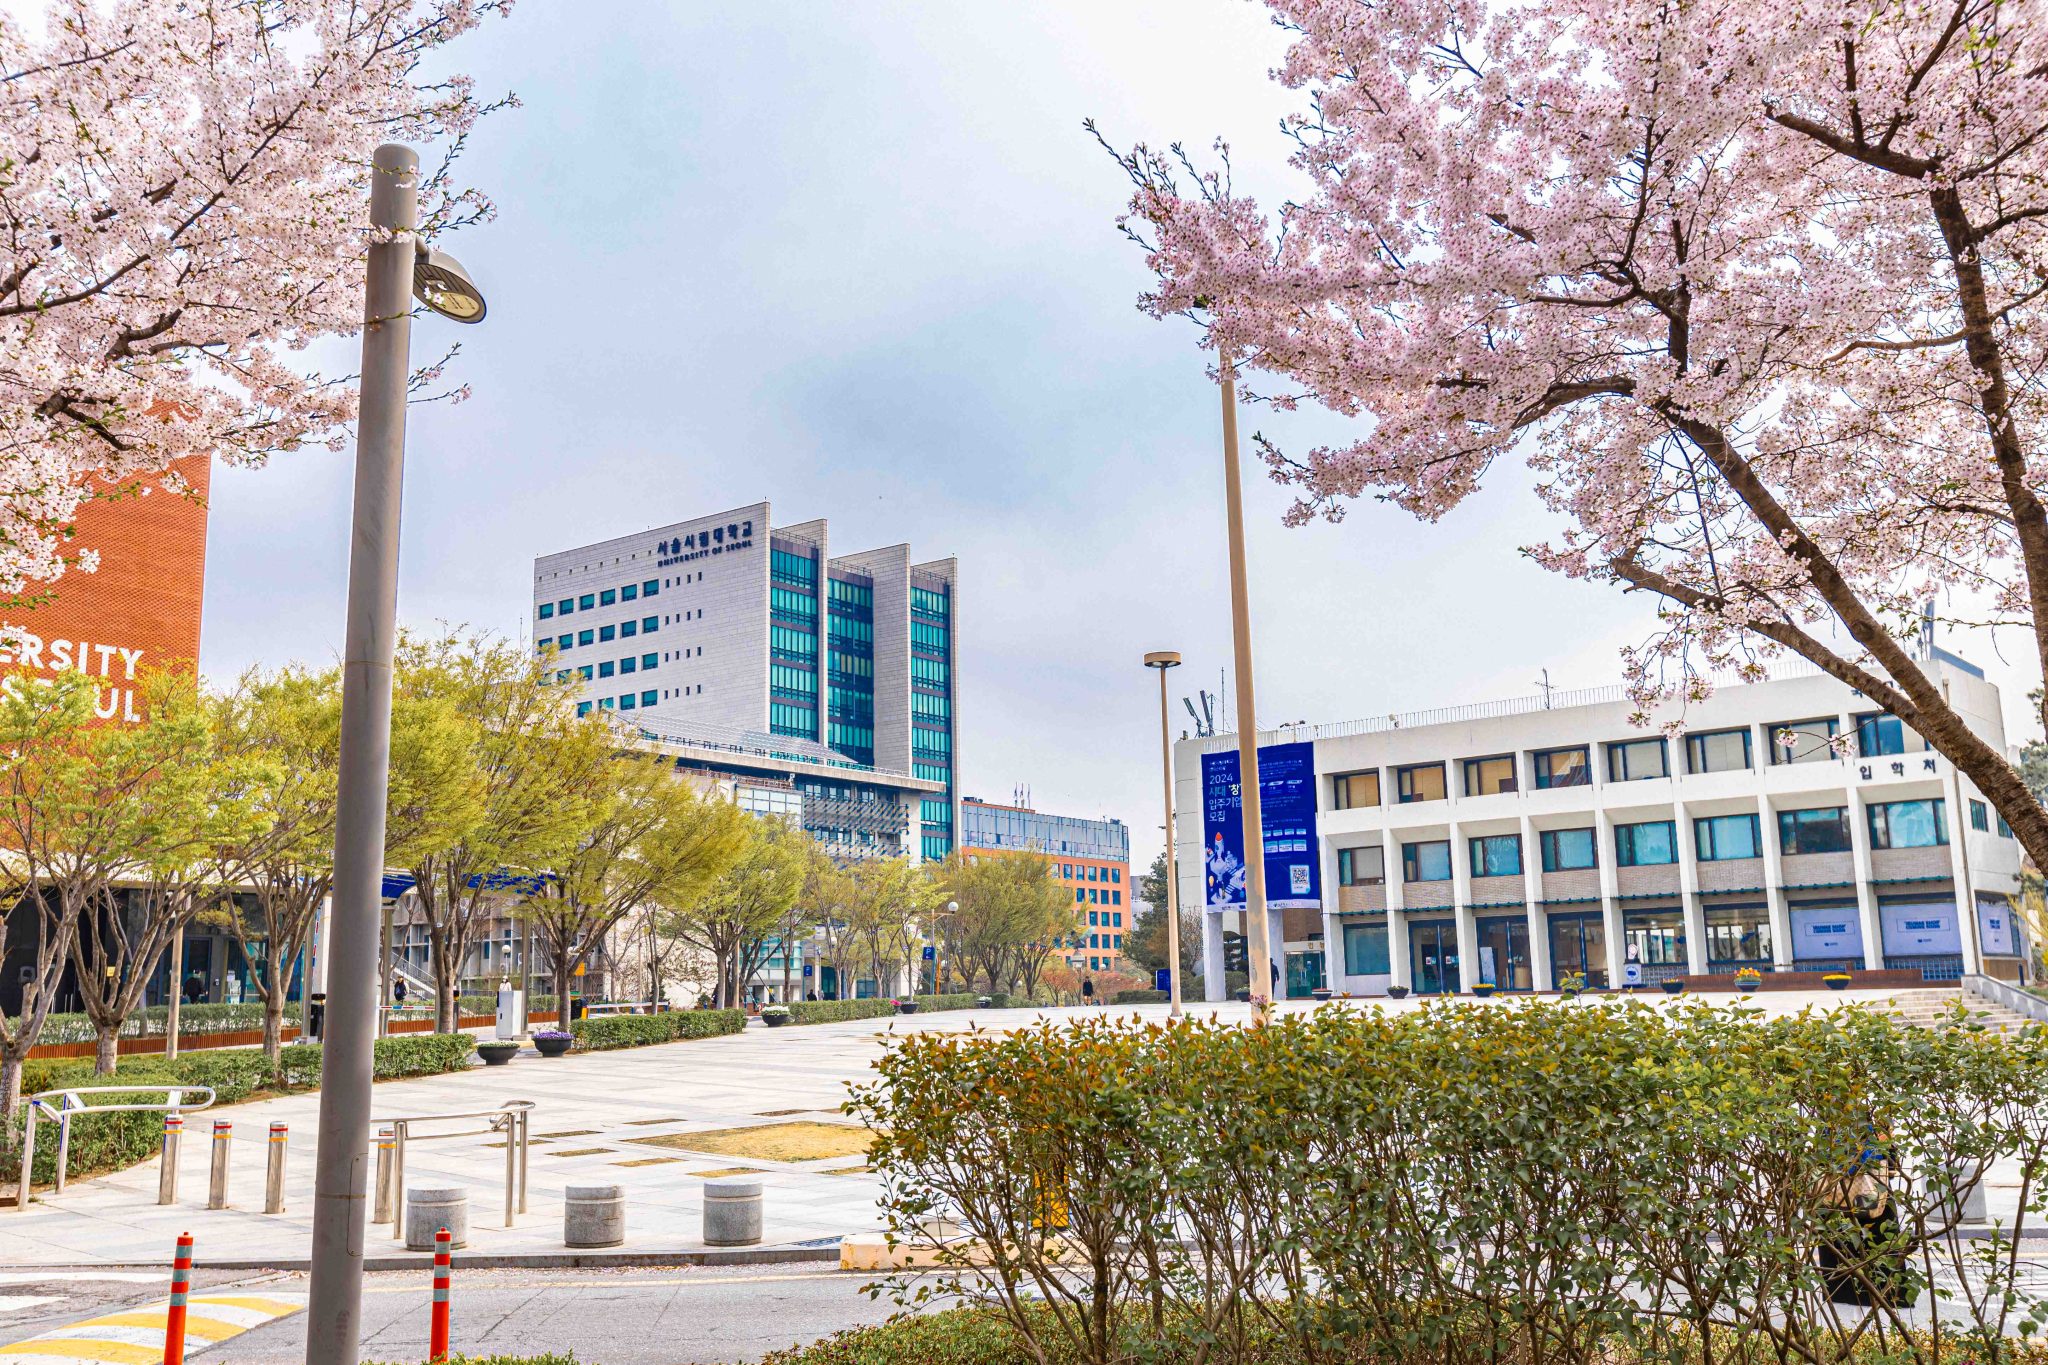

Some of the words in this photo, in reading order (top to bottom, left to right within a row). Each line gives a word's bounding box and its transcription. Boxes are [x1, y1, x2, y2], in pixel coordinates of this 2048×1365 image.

[658, 549, 709, 567] UNIVERSITY
[712, 546, 722, 555] OF
[726, 540, 752, 552] SEOUL
[1860, 758, 1936, 780] 입학처
[1209, 773, 1233, 785] 2024
[1209, 785, 1226, 797] 시대
[1209, 810, 1226, 822] 모집
